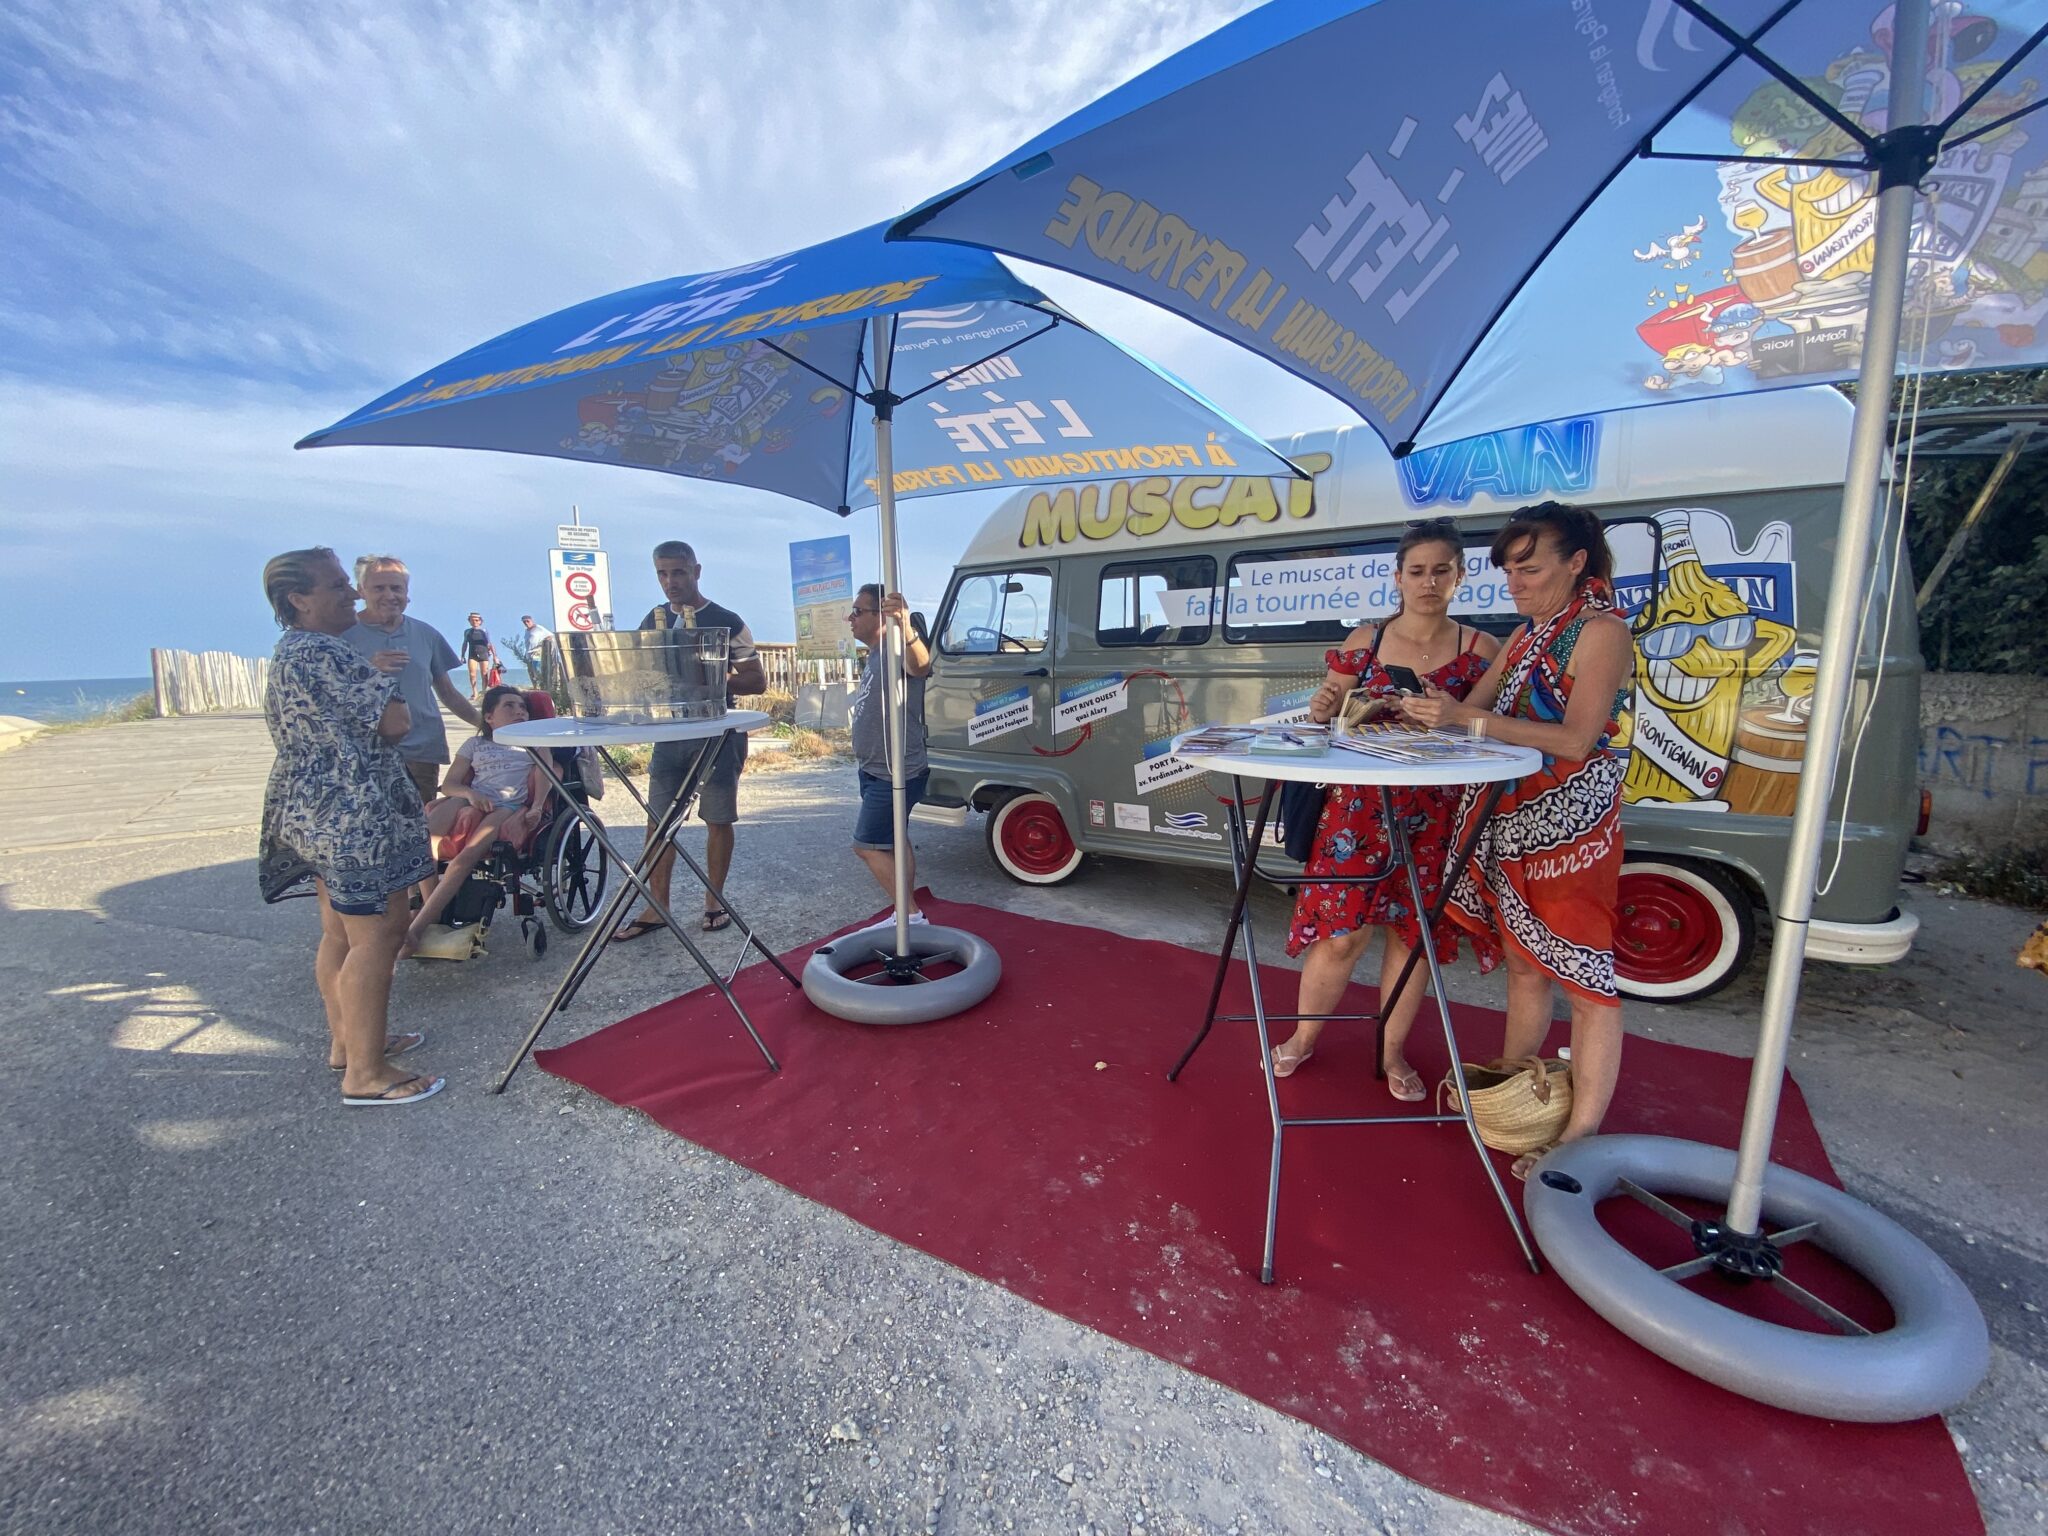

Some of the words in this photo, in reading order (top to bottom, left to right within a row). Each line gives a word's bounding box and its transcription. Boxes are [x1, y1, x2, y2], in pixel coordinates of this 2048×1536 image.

[697, 273, 943, 344] PEYRADE
[1018, 452, 1333, 548] MUSCAT
[1400, 416, 1598, 505] VAN
[1251, 569, 1273, 586] Le
[1279, 562, 1355, 585] muscat
[1360, 558, 1390, 579] de
[1186, 594, 1222, 617] fait
[1229, 592, 1249, 614] la
[1256, 585, 1360, 614] tournée
[1060, 704, 1078, 716] PORT
[1078, 698, 1094, 711] RIVE
[1095, 690, 1118, 704] OUEST
[1075, 711, 1090, 723] quai
[1090, 706, 1108, 718] Alary
[1282, 698, 1291, 708] 24
[970, 716, 996, 731] QUARTIER
[995, 712, 1004, 722] DE
[1003, 703, 1030, 719] L'ENTRÉE
[975, 727, 996, 739] impasse
[995, 722, 1005, 732] des
[1004, 715, 1029, 731] Foulques
[1149, 760, 1169, 772] PORT
[1138, 779, 1149, 787] av.
